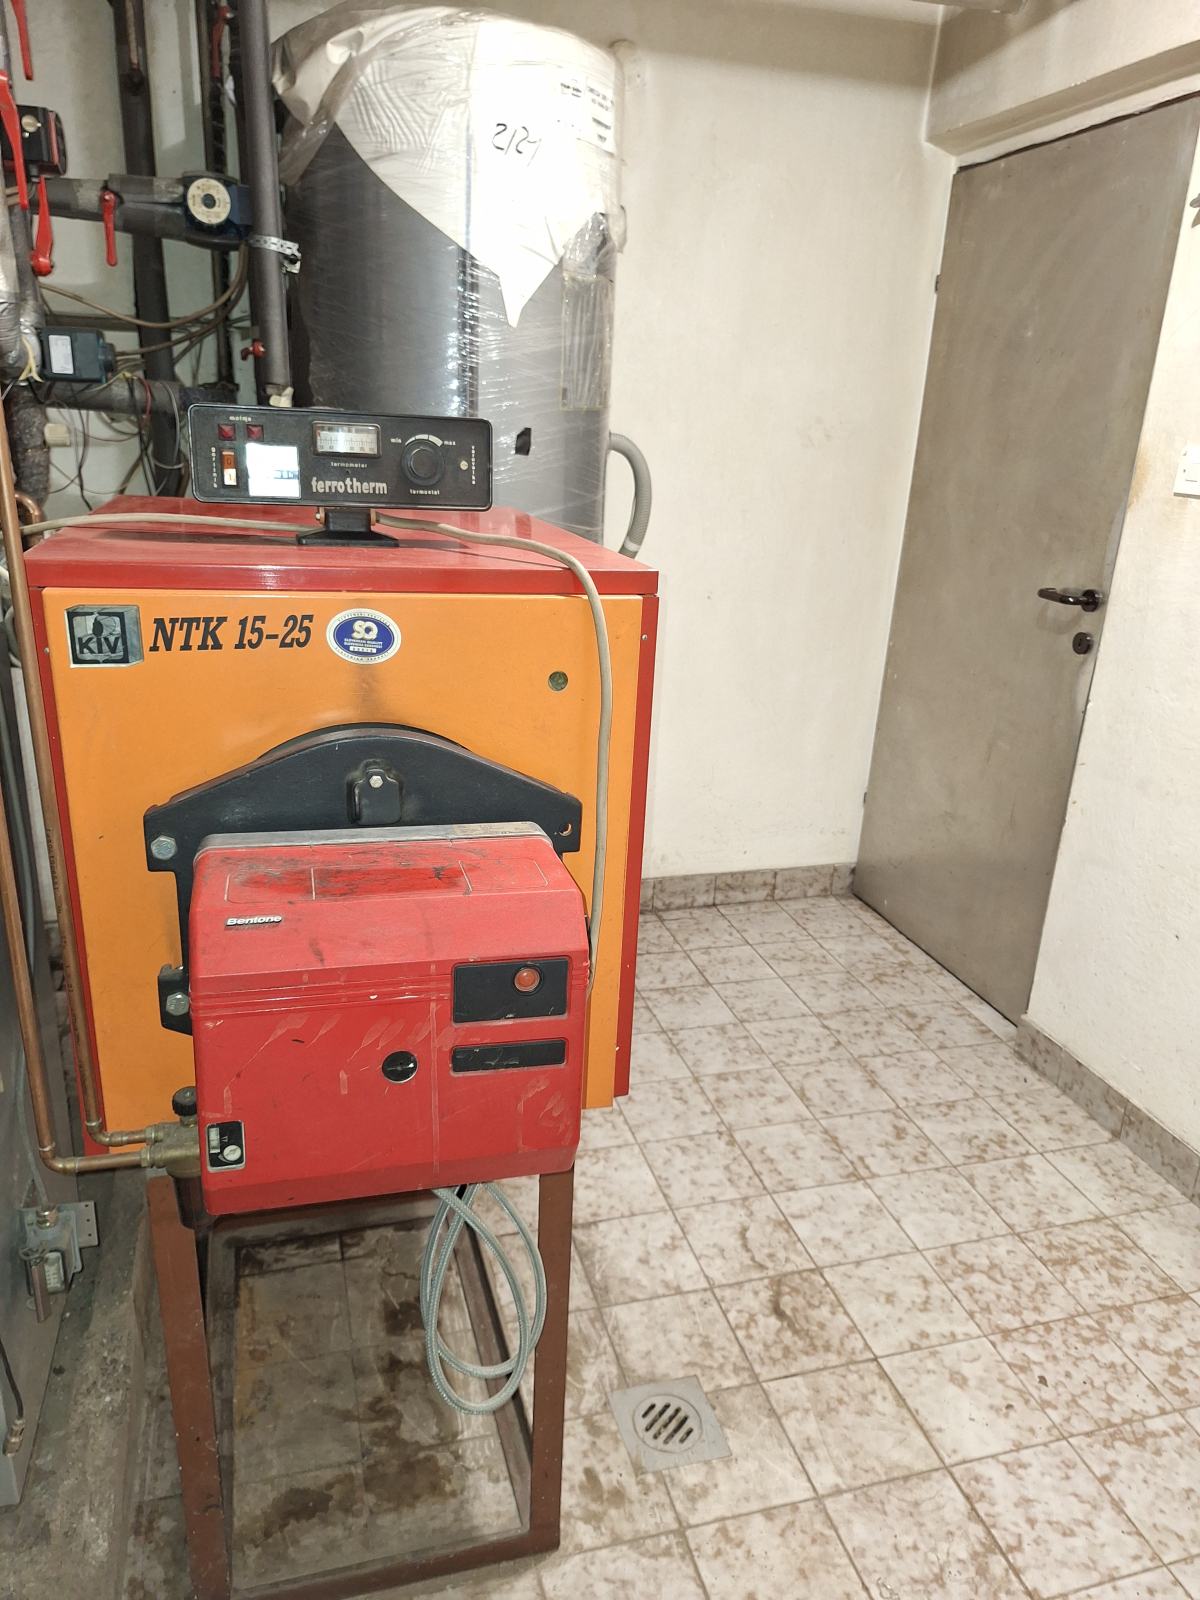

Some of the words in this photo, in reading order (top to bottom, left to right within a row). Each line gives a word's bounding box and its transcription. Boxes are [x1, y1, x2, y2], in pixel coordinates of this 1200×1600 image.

[311, 477, 388, 495] ferrotherm
[149, 616, 228, 652] NTK
[233, 614, 314, 650] 15-25
[77, 636, 121, 655] KIV
[226, 916, 281, 926] Bentone
